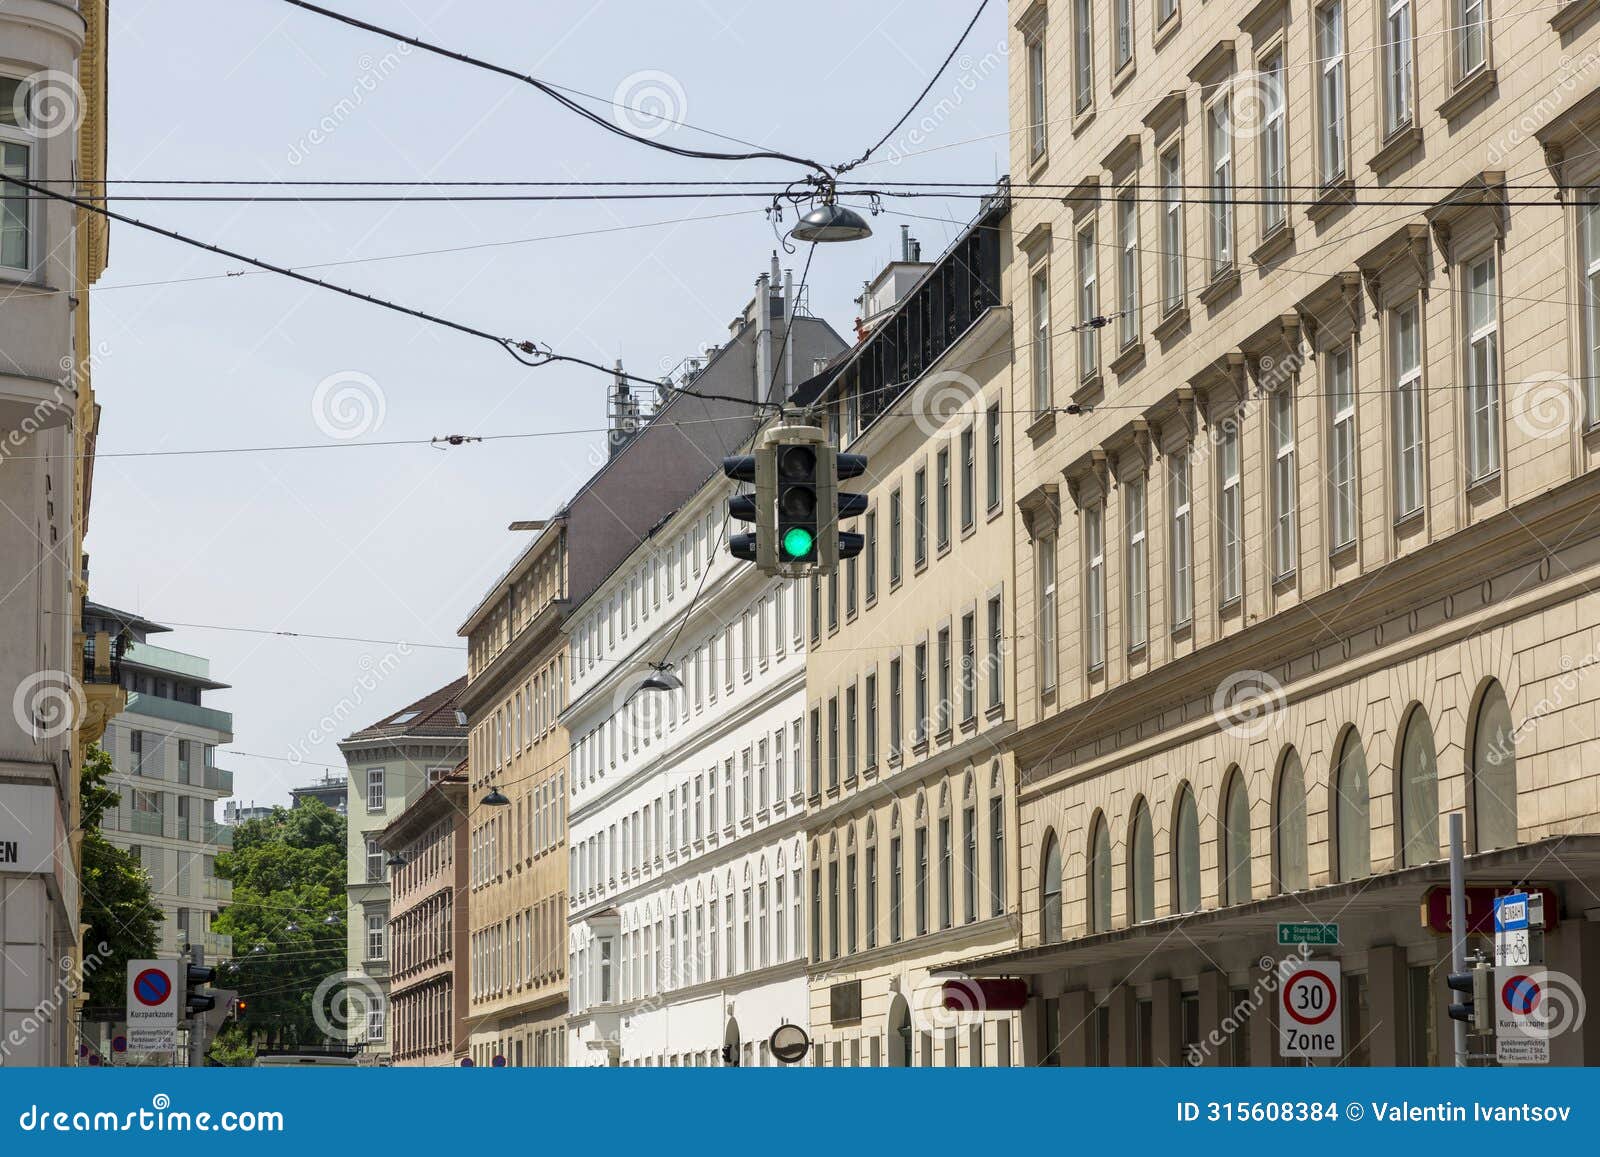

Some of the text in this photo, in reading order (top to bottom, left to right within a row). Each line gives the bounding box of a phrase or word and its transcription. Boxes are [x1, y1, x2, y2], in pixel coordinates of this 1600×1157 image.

[1297, 985, 1323, 1010] 30
[130, 1010, 174, 1019] Kurzparkzone
[1287, 1029, 1335, 1050] Zone
